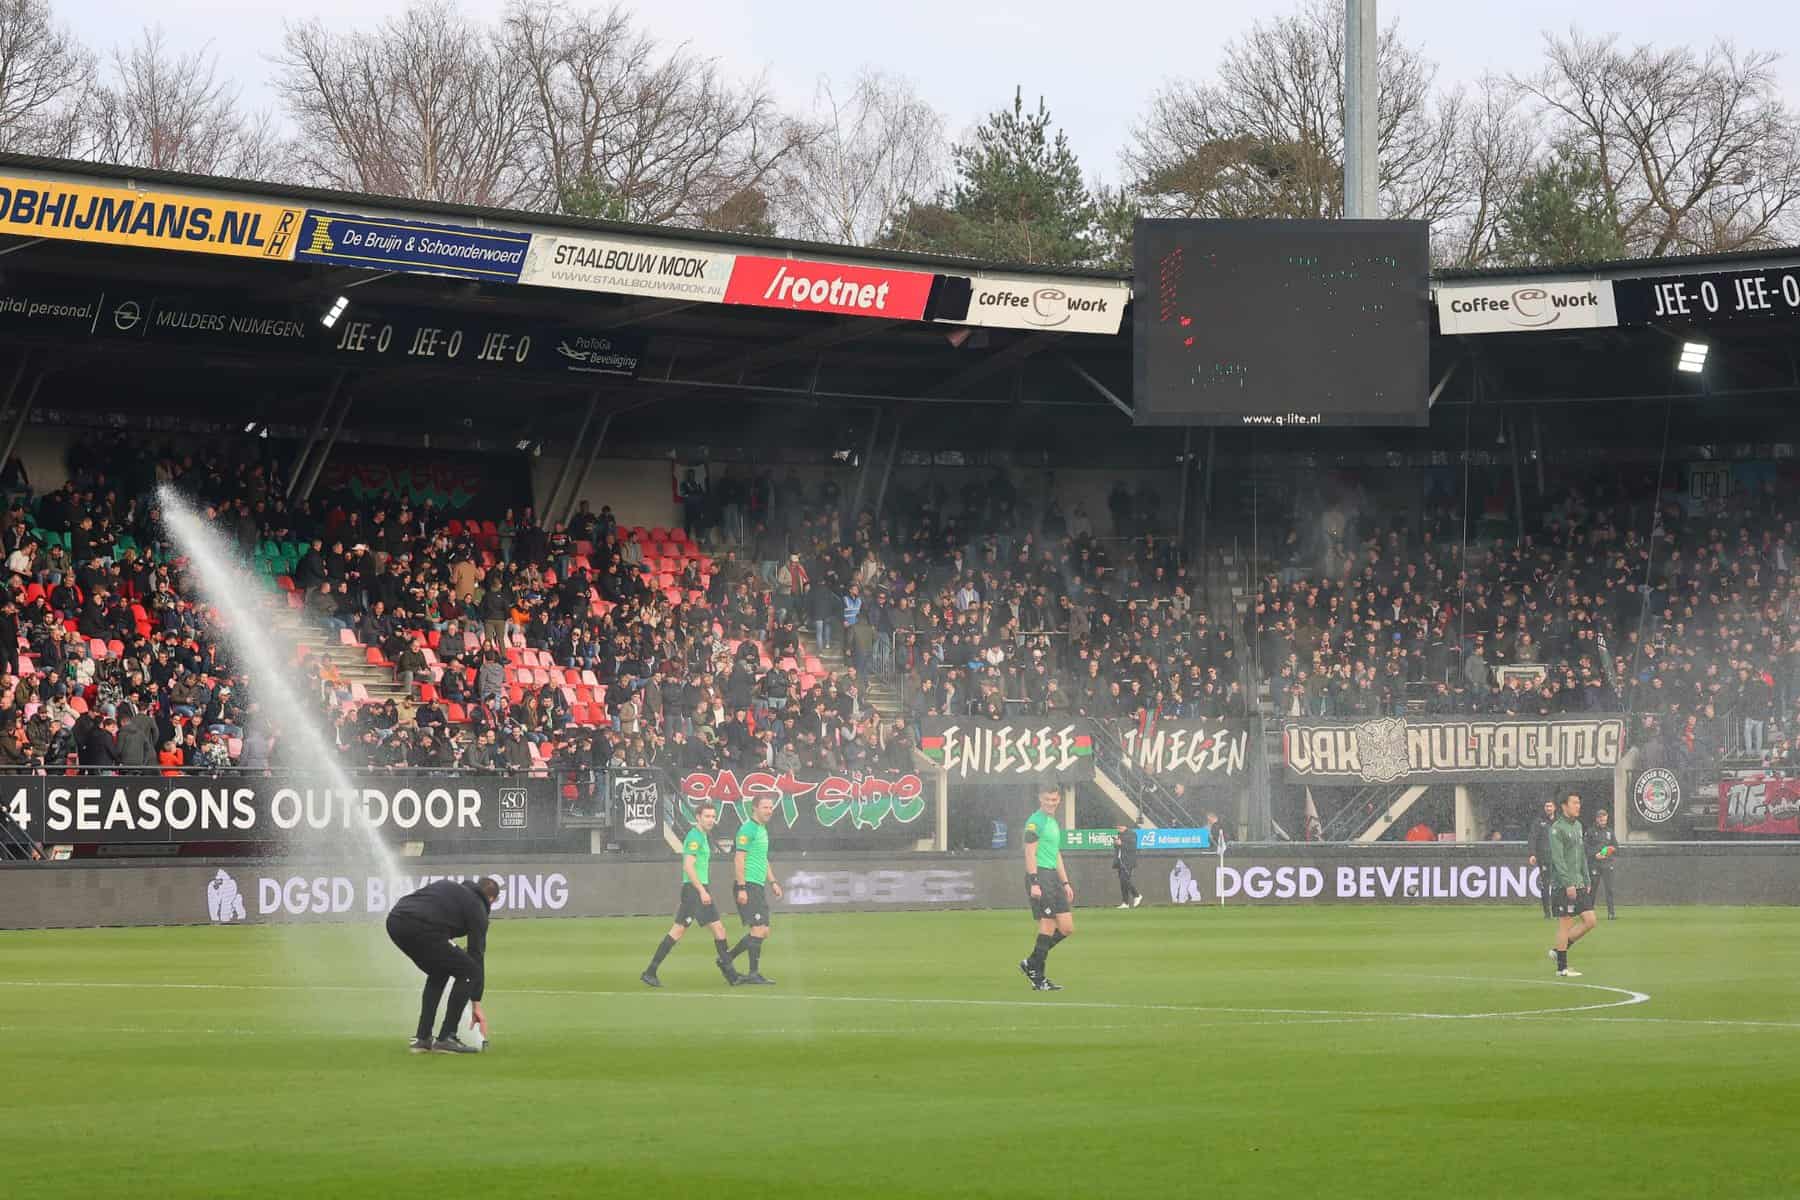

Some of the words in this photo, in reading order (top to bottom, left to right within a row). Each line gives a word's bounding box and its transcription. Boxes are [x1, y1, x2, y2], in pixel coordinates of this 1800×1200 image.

[342, 230, 361, 247] De
[365, 233, 402, 253] Bruijn
[405, 237, 414, 251] &
[418, 238, 523, 264] Schoonderwoerd
[554, 245, 656, 273] STAALBOUW
[659, 256, 708, 278] MOOK
[551, 271, 722, 296] WWW.STAALBOUWMOOK.NL
[28, 303, 92, 318] personal.
[979, 292, 1029, 308] Coffee
[1068, 297, 1107, 312] Work
[1451, 298, 1509, 313] Coffee
[1552, 292, 1598, 308] Work
[157, 311, 225, 330] MULDERS
[1242, 413, 1321, 425] www.q-lite.nl
[1407, 724, 1619, 769] NULTACHTIG
[9, 788, 31, 830] 4
[47, 788, 256, 830] SEASONS
[271, 788, 482, 828] OUTDOOR
[627, 805, 653, 817] NEC
[259, 874, 354, 914] DGSD
[1215, 866, 1323, 898] DGSD
